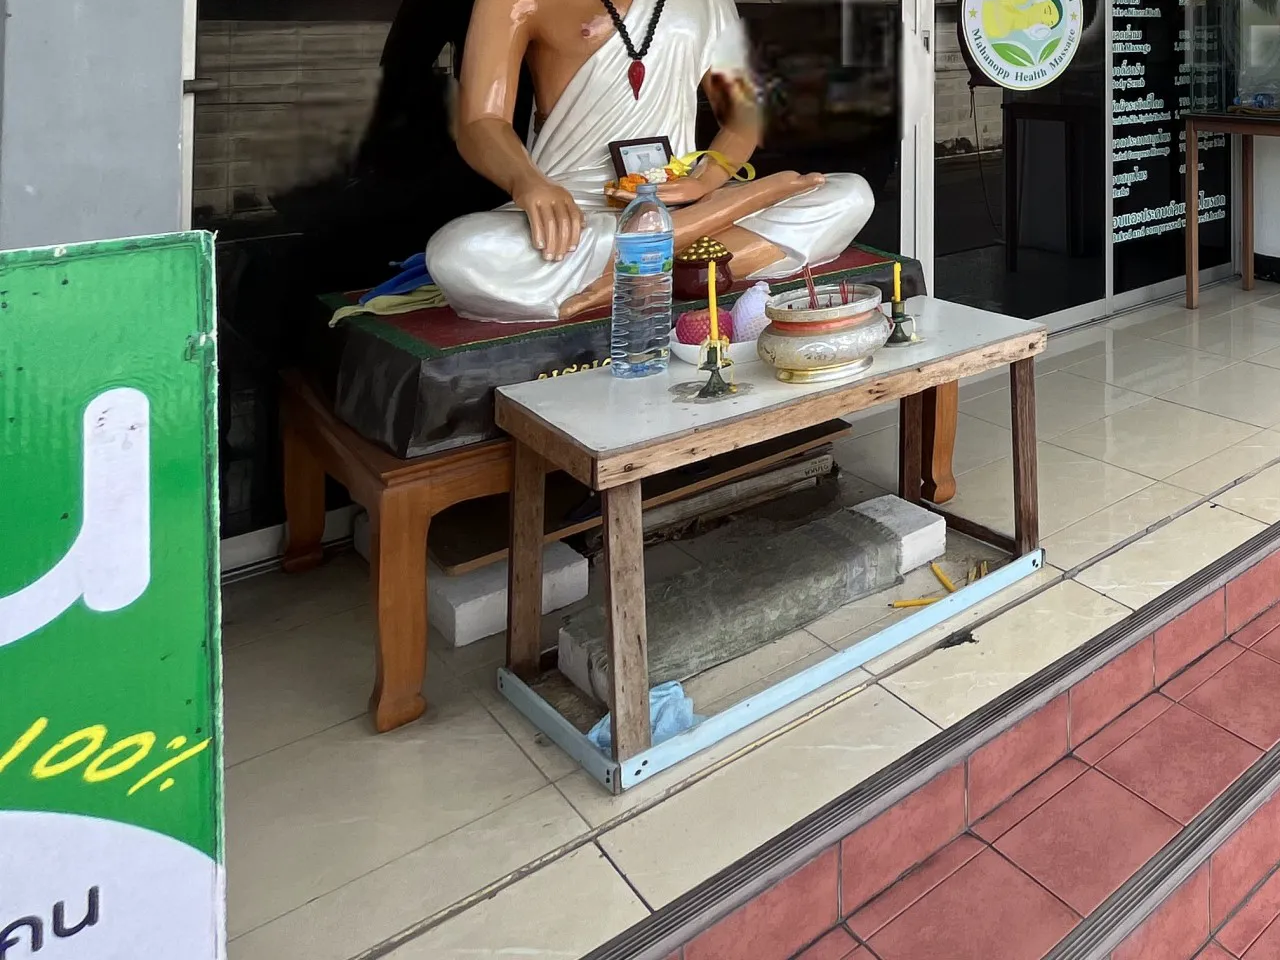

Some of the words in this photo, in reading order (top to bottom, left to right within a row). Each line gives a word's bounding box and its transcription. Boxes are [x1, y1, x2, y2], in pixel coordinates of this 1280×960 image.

[972, 28, 1010, 79] Mahanopp
[1014, 68, 1048, 82] Health
[1049, 28, 1076, 71] Massage
[1125, 43, 1151, 55] Massage
[1133, 226, 1145, 239] and
[1145, 218, 1181, 235] compressed
[1210, 209, 1226, 220] herbs
[0, 716, 213, 797] 100%
